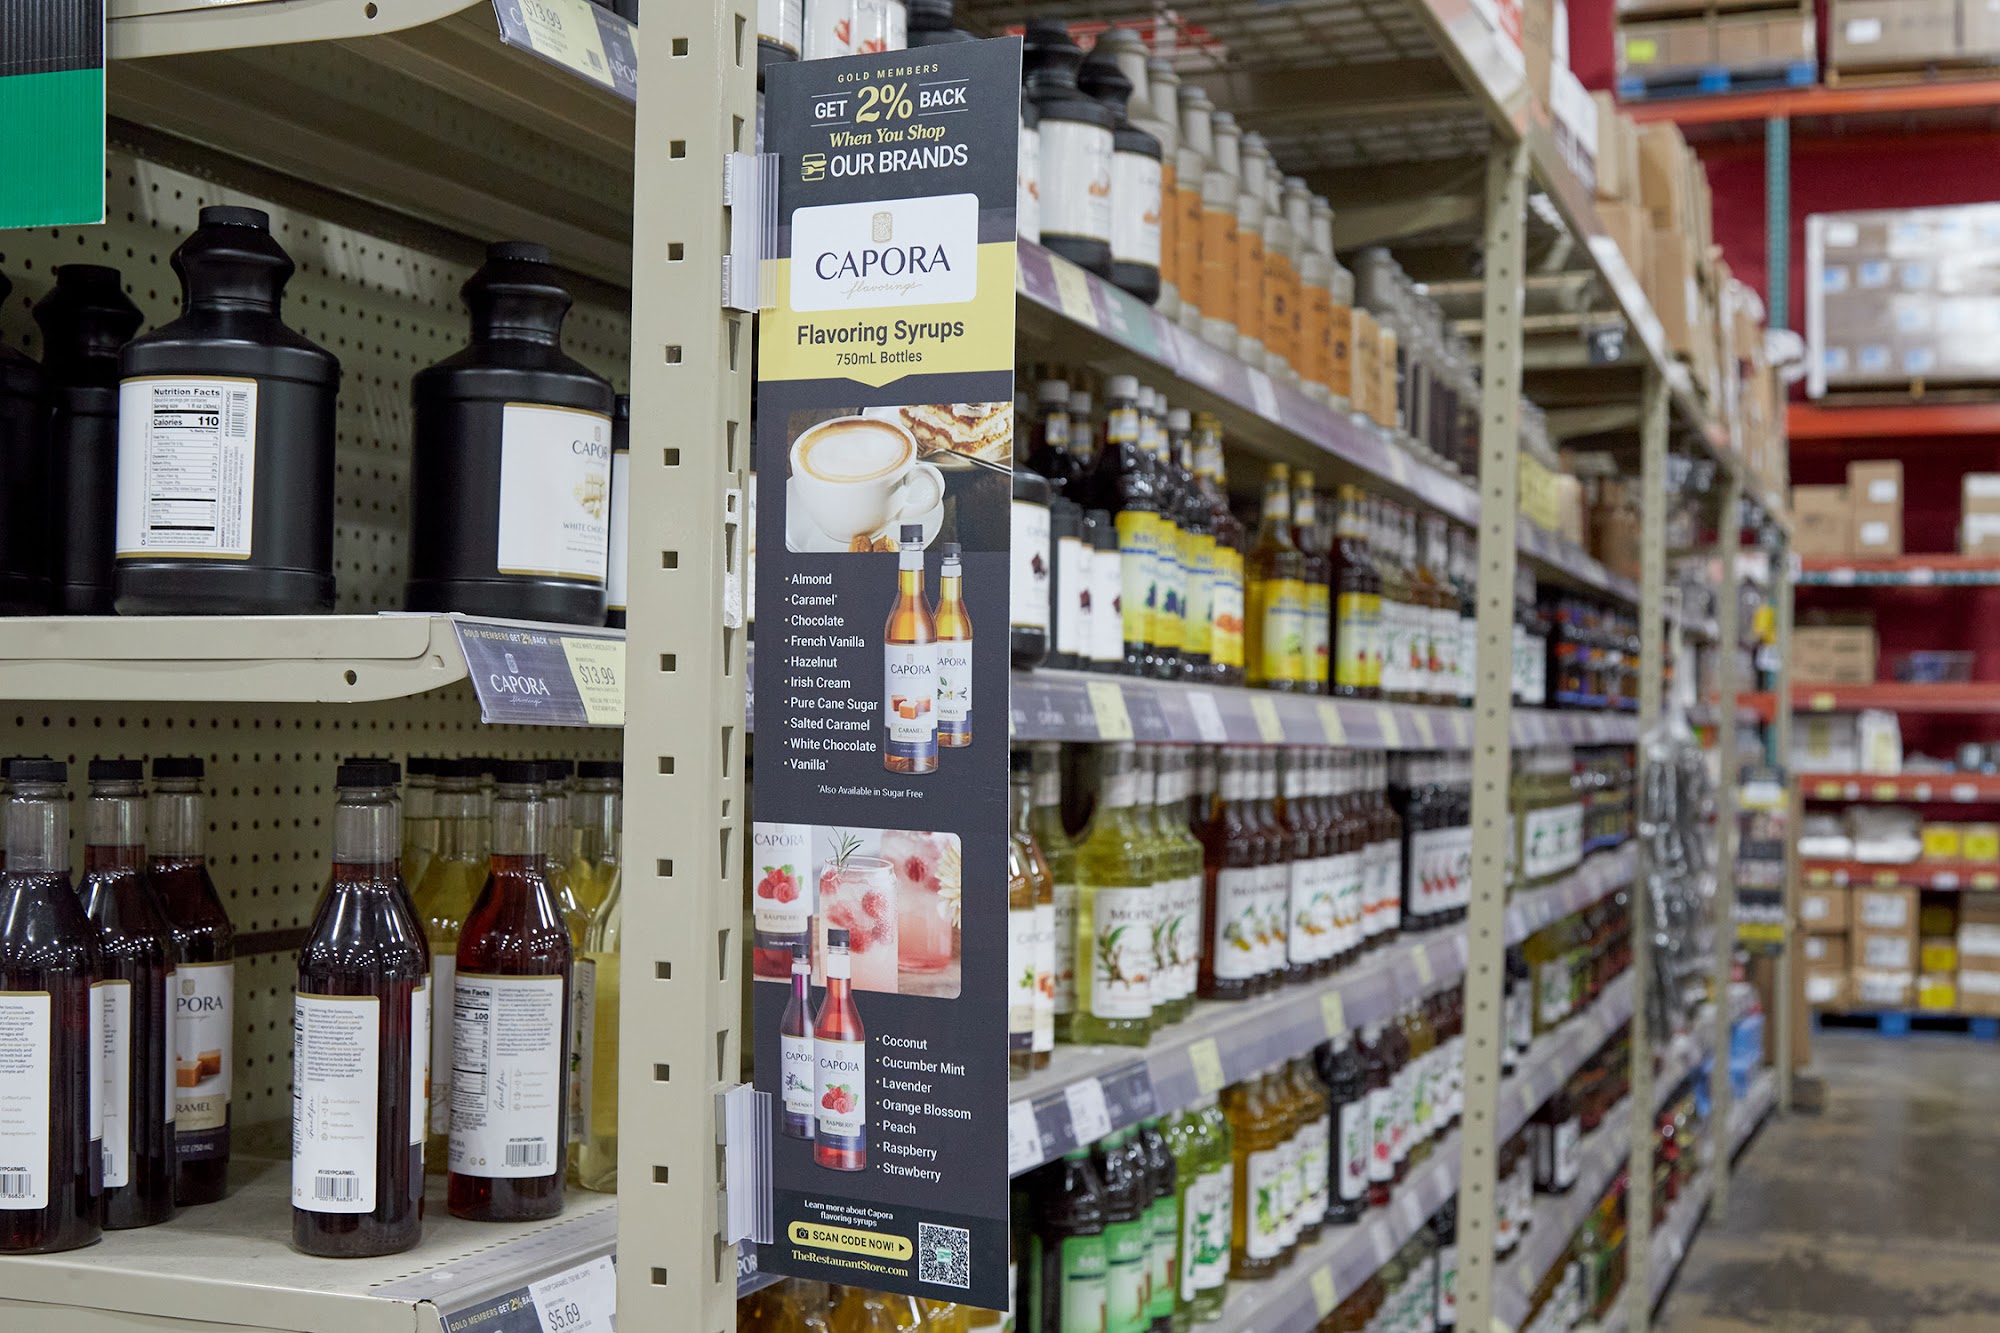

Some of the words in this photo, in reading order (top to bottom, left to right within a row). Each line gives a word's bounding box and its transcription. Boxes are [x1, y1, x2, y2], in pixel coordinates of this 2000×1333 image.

[838, 72, 869, 82] GOLD
[877, 64, 939, 79] MEMBERS
[815, 100, 848, 119] GET
[856, 82, 913, 123] 2%
[920, 87, 966, 108] BACK
[830, 131, 871, 148] When
[876, 127, 903, 143] You
[907, 124, 945, 142] Shop
[830, 153, 875, 177] OUR
[879, 144, 968, 173] BRANDS
[815, 244, 950, 280] CAPORA
[798, 322, 887, 346] Flavoring
[894, 320, 964, 343] Syrups
[836, 352, 876, 365] 750mL
[880, 350, 922, 363] Bottles
[199, 416, 219, 426] 110
[572, 440, 608, 460] CAPOR
[791, 574, 831, 585] Almond
[791, 615, 844, 627] Chocolate
[464, 629, 479, 638] GOLD
[481, 631, 509, 641] MEMBERS
[510, 634, 520, 642] GET
[521, 633, 533, 645] 2%
[532, 636, 547, 644] BACK
[791, 636, 826, 647] French
[829, 636, 864, 648] Vanilla
[791, 657, 837, 668] Hazelnut
[891, 664, 931, 674] CAPORA
[579, 664, 615, 685] $13.99
[490, 674, 550, 695] CAPORA
[791, 677, 813, 688] Irish
[816, 677, 850, 689] Cream
[791, 698, 814, 709] Pure
[817, 698, 844, 710] Cane
[847, 699, 878, 712] Sugar
[790, 718, 823, 730] Salted
[827, 719, 870, 731] Caramel
[791, 739, 820, 750] White
[823, 739, 876, 752] Chocolate
[838, 785, 872, 796] Available
[874, 786, 881, 796] in
[882, 788, 904, 799] Sugar
[906, 789, 923, 798] Free
[755, 833, 804, 846] CAPORA
[176, 997, 223, 1012] PORA
[882, 1035, 927, 1050] Coconut
[820, 1059, 859, 1071] CAPORA
[882, 1056, 937, 1073] Cucumber
[941, 1062, 965, 1076] Mint
[883, 1078, 932, 1093] Lavender
[176, 1102, 212, 1113] RAMEL
[883, 1099, 921, 1115] Orange
[924, 1103, 971, 1120] Blossom
[883, 1121, 916, 1134] Peach
[883, 1142, 937, 1161] Raspberry
[883, 1163, 941, 1183] Strawberry
[805, 1200, 824, 1210] Learn
[826, 1204, 844, 1213] more
[846, 1205, 866, 1215] about
[868, 1208, 893, 1220] Capora
[821, 1211, 852, 1224] flavoring
[853, 1216, 877, 1227] syrups
[813, 1231, 839, 1243] SCAN
[841, 1236, 866, 1248] CODE
[869, 1239, 894, 1252] NOW!
[737, 1254, 758, 1277] POR
[792, 1250, 908, 1277] TheRestaurantStore.com
[450, 1319, 467, 1332] GOLD
[468, 1307, 499, 1325] MEMBERS
[498, 1303, 510, 1314] GET
[509, 1296, 523, 1311] 2%
[548, 1303, 580, 1333] $5.69
